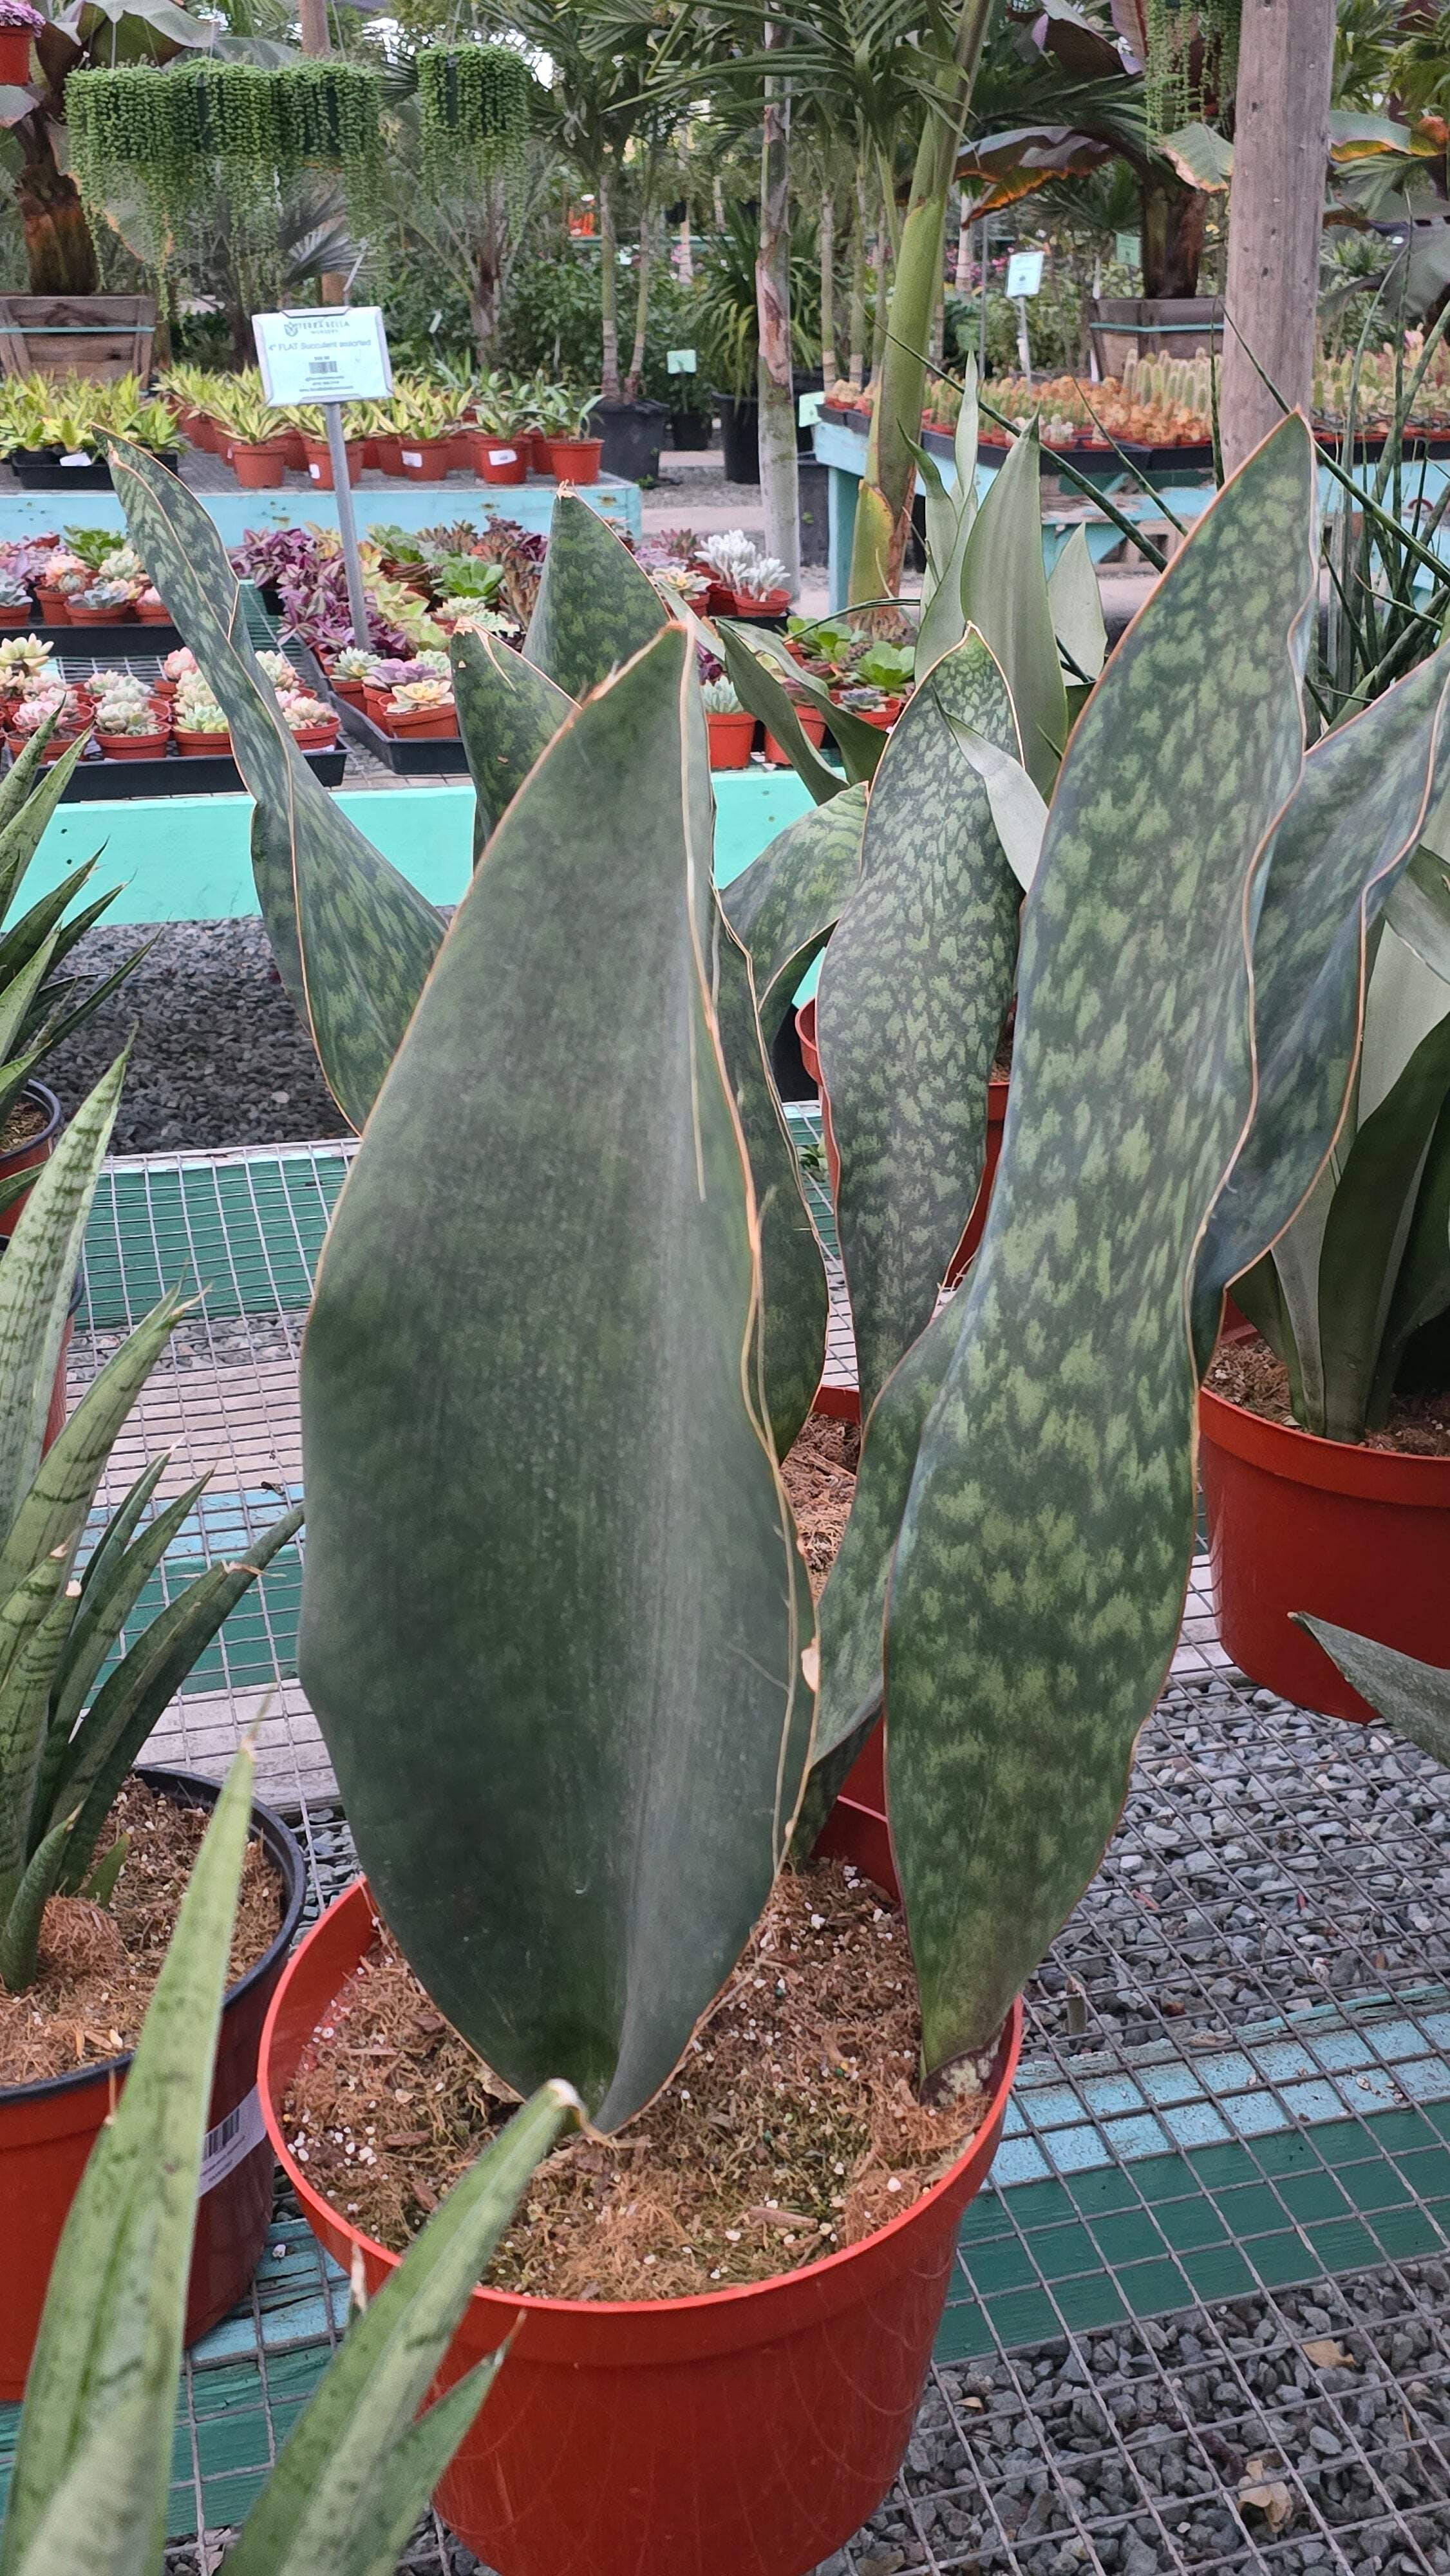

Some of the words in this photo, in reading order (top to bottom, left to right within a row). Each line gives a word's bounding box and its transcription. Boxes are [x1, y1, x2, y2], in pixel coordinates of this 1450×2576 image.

[278, 343, 298, 351] FLAT
[301, 341, 338, 350] Succulent
[339, 339, 372, 348] assorted
